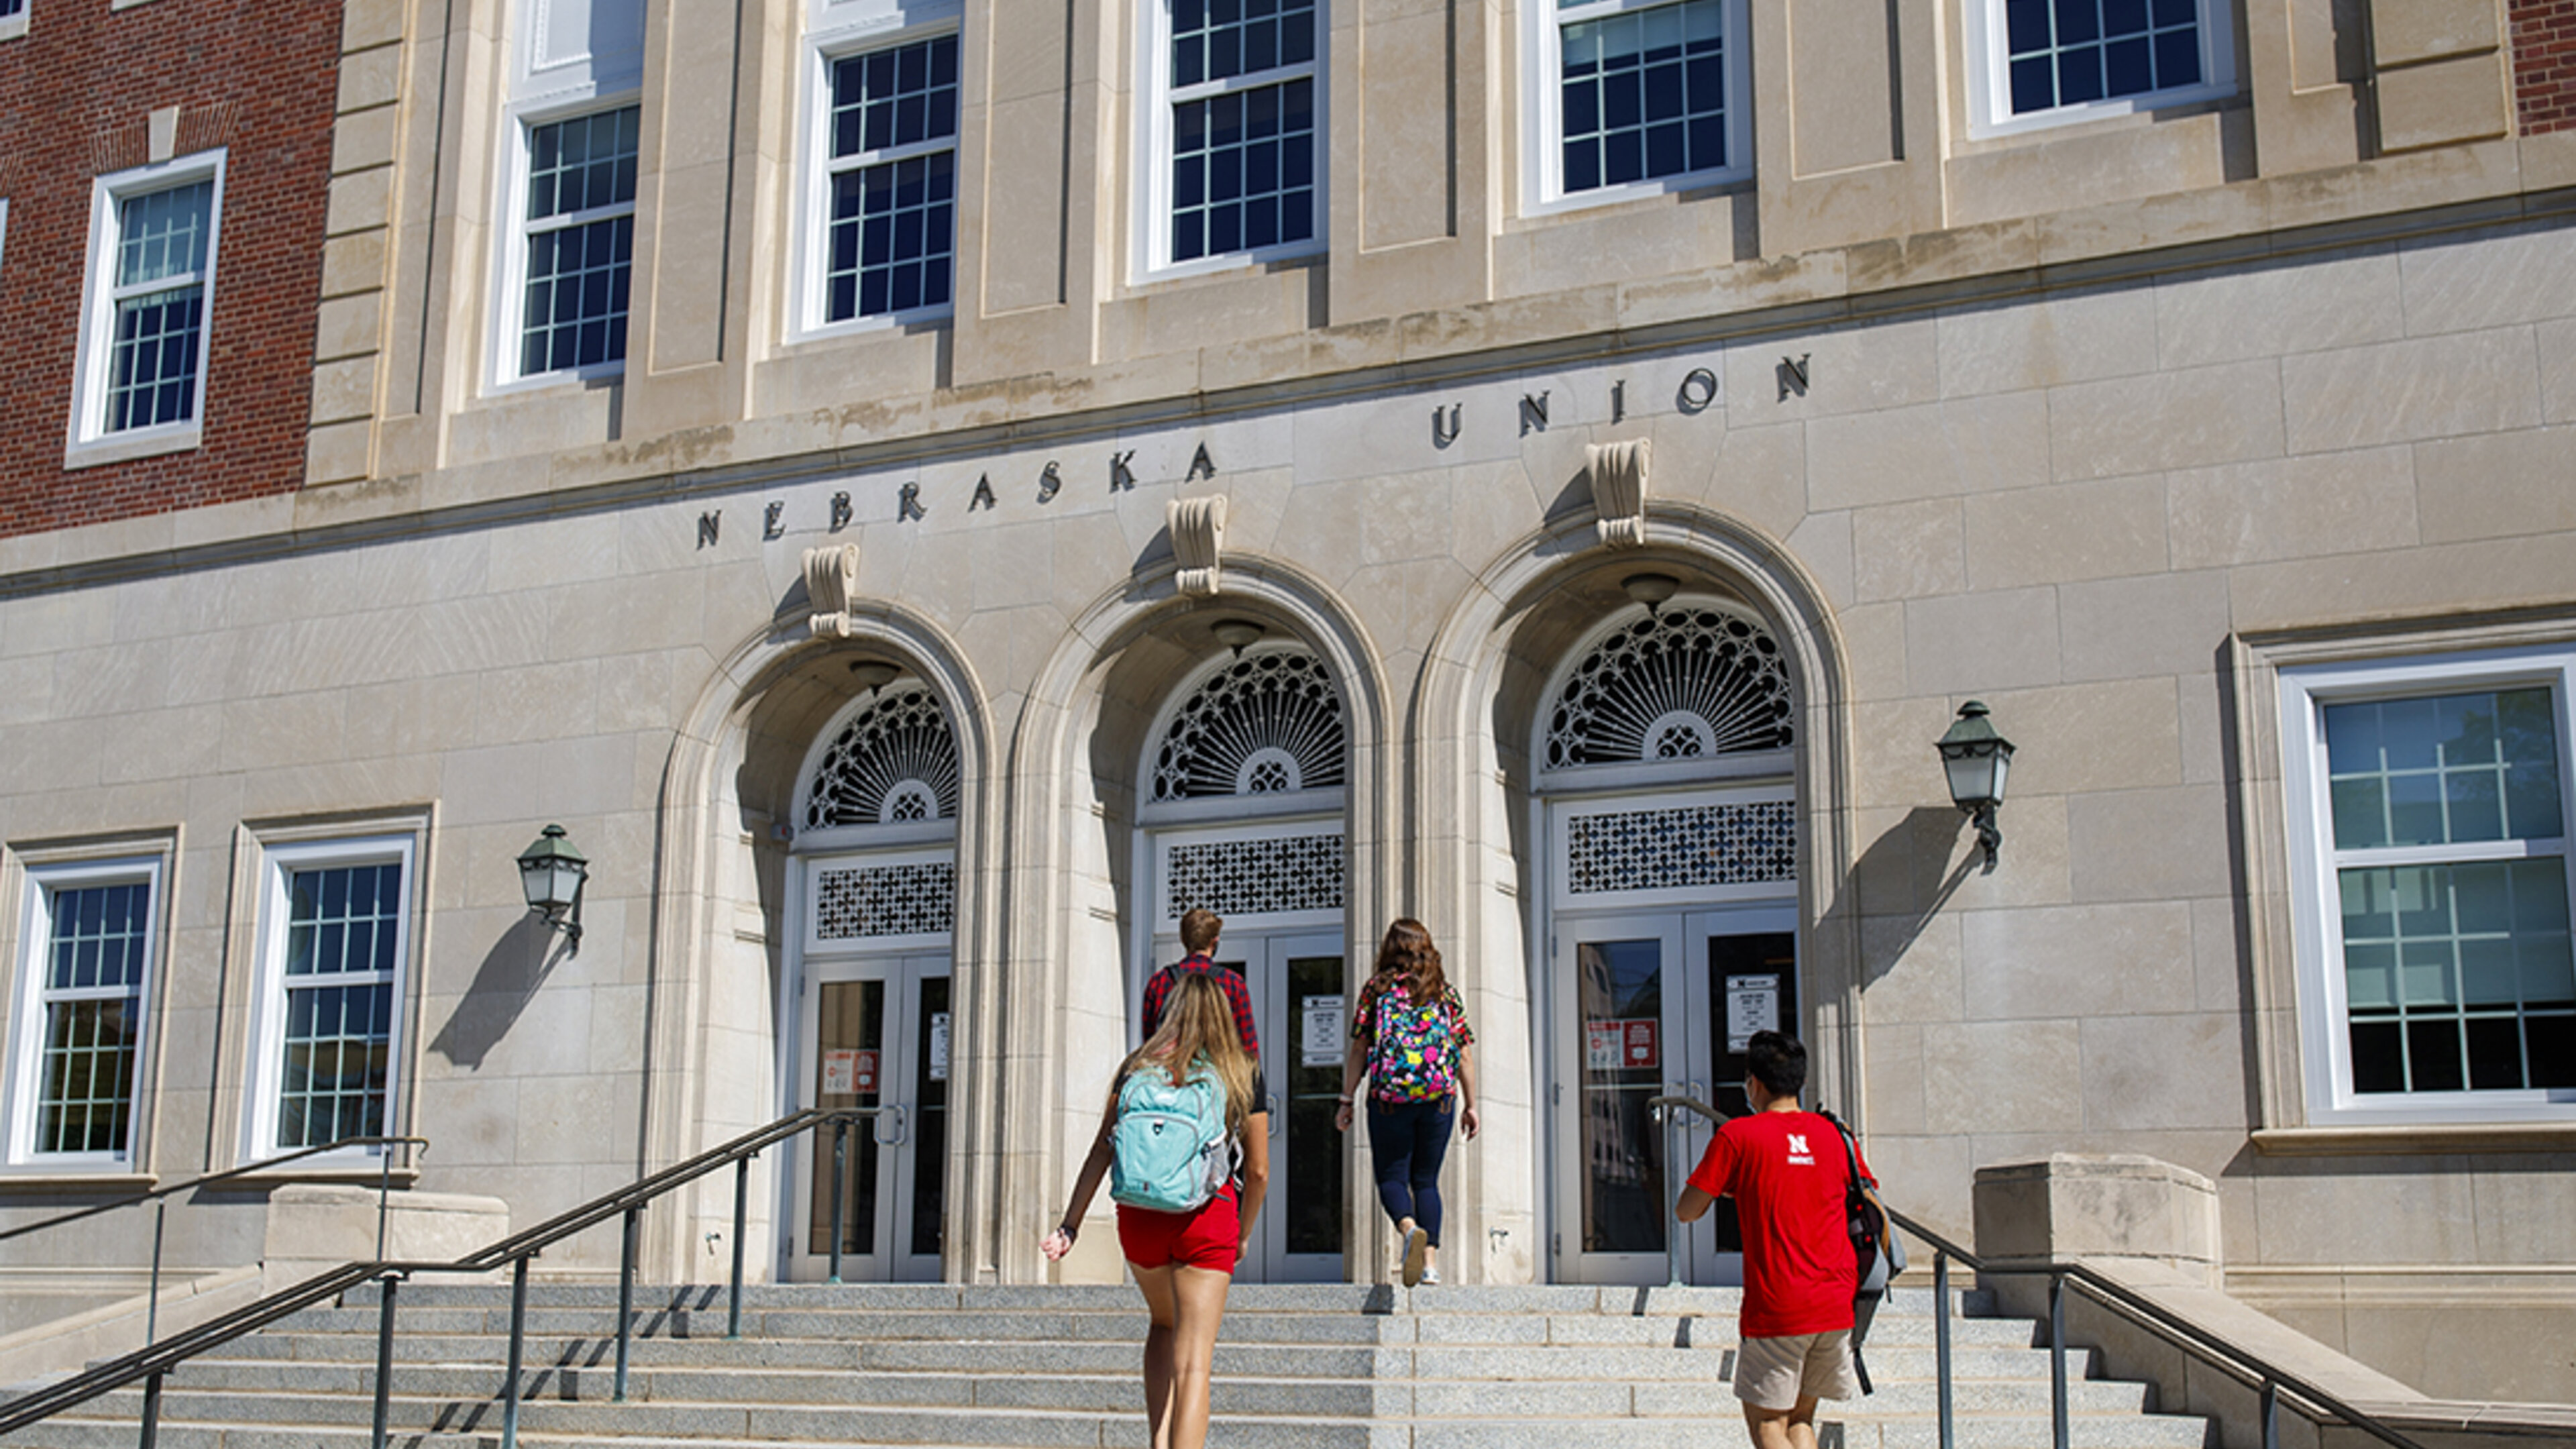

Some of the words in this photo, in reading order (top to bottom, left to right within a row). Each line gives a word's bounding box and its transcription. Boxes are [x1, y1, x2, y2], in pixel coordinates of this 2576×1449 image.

[697, 441, 1216, 549] NEBRASKA
[1434, 354, 1811, 448] UNION
[1787, 1134, 1810, 1153] N
